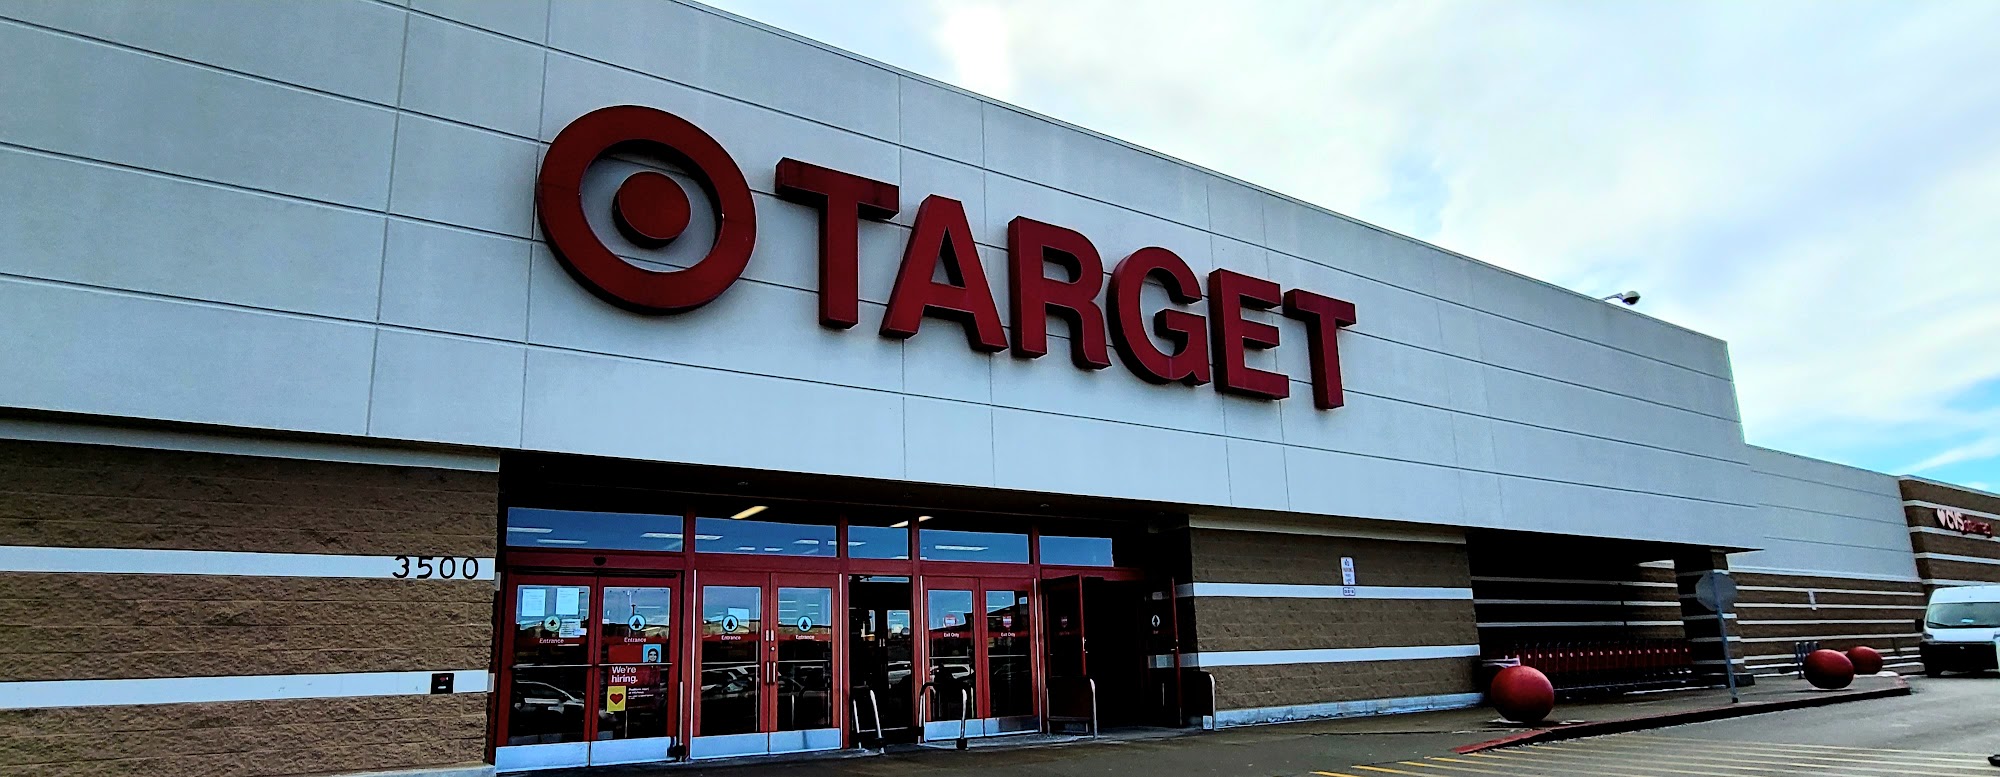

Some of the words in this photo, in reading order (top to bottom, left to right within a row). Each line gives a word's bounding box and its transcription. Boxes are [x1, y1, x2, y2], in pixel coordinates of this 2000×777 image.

[775, 156, 1356, 411] TARGET
[1946, 509, 1964, 531] CVS
[392, 555, 479, 579] 3500
[611, 665, 637, 674] We're
[611, 675, 638, 684] hiring.
